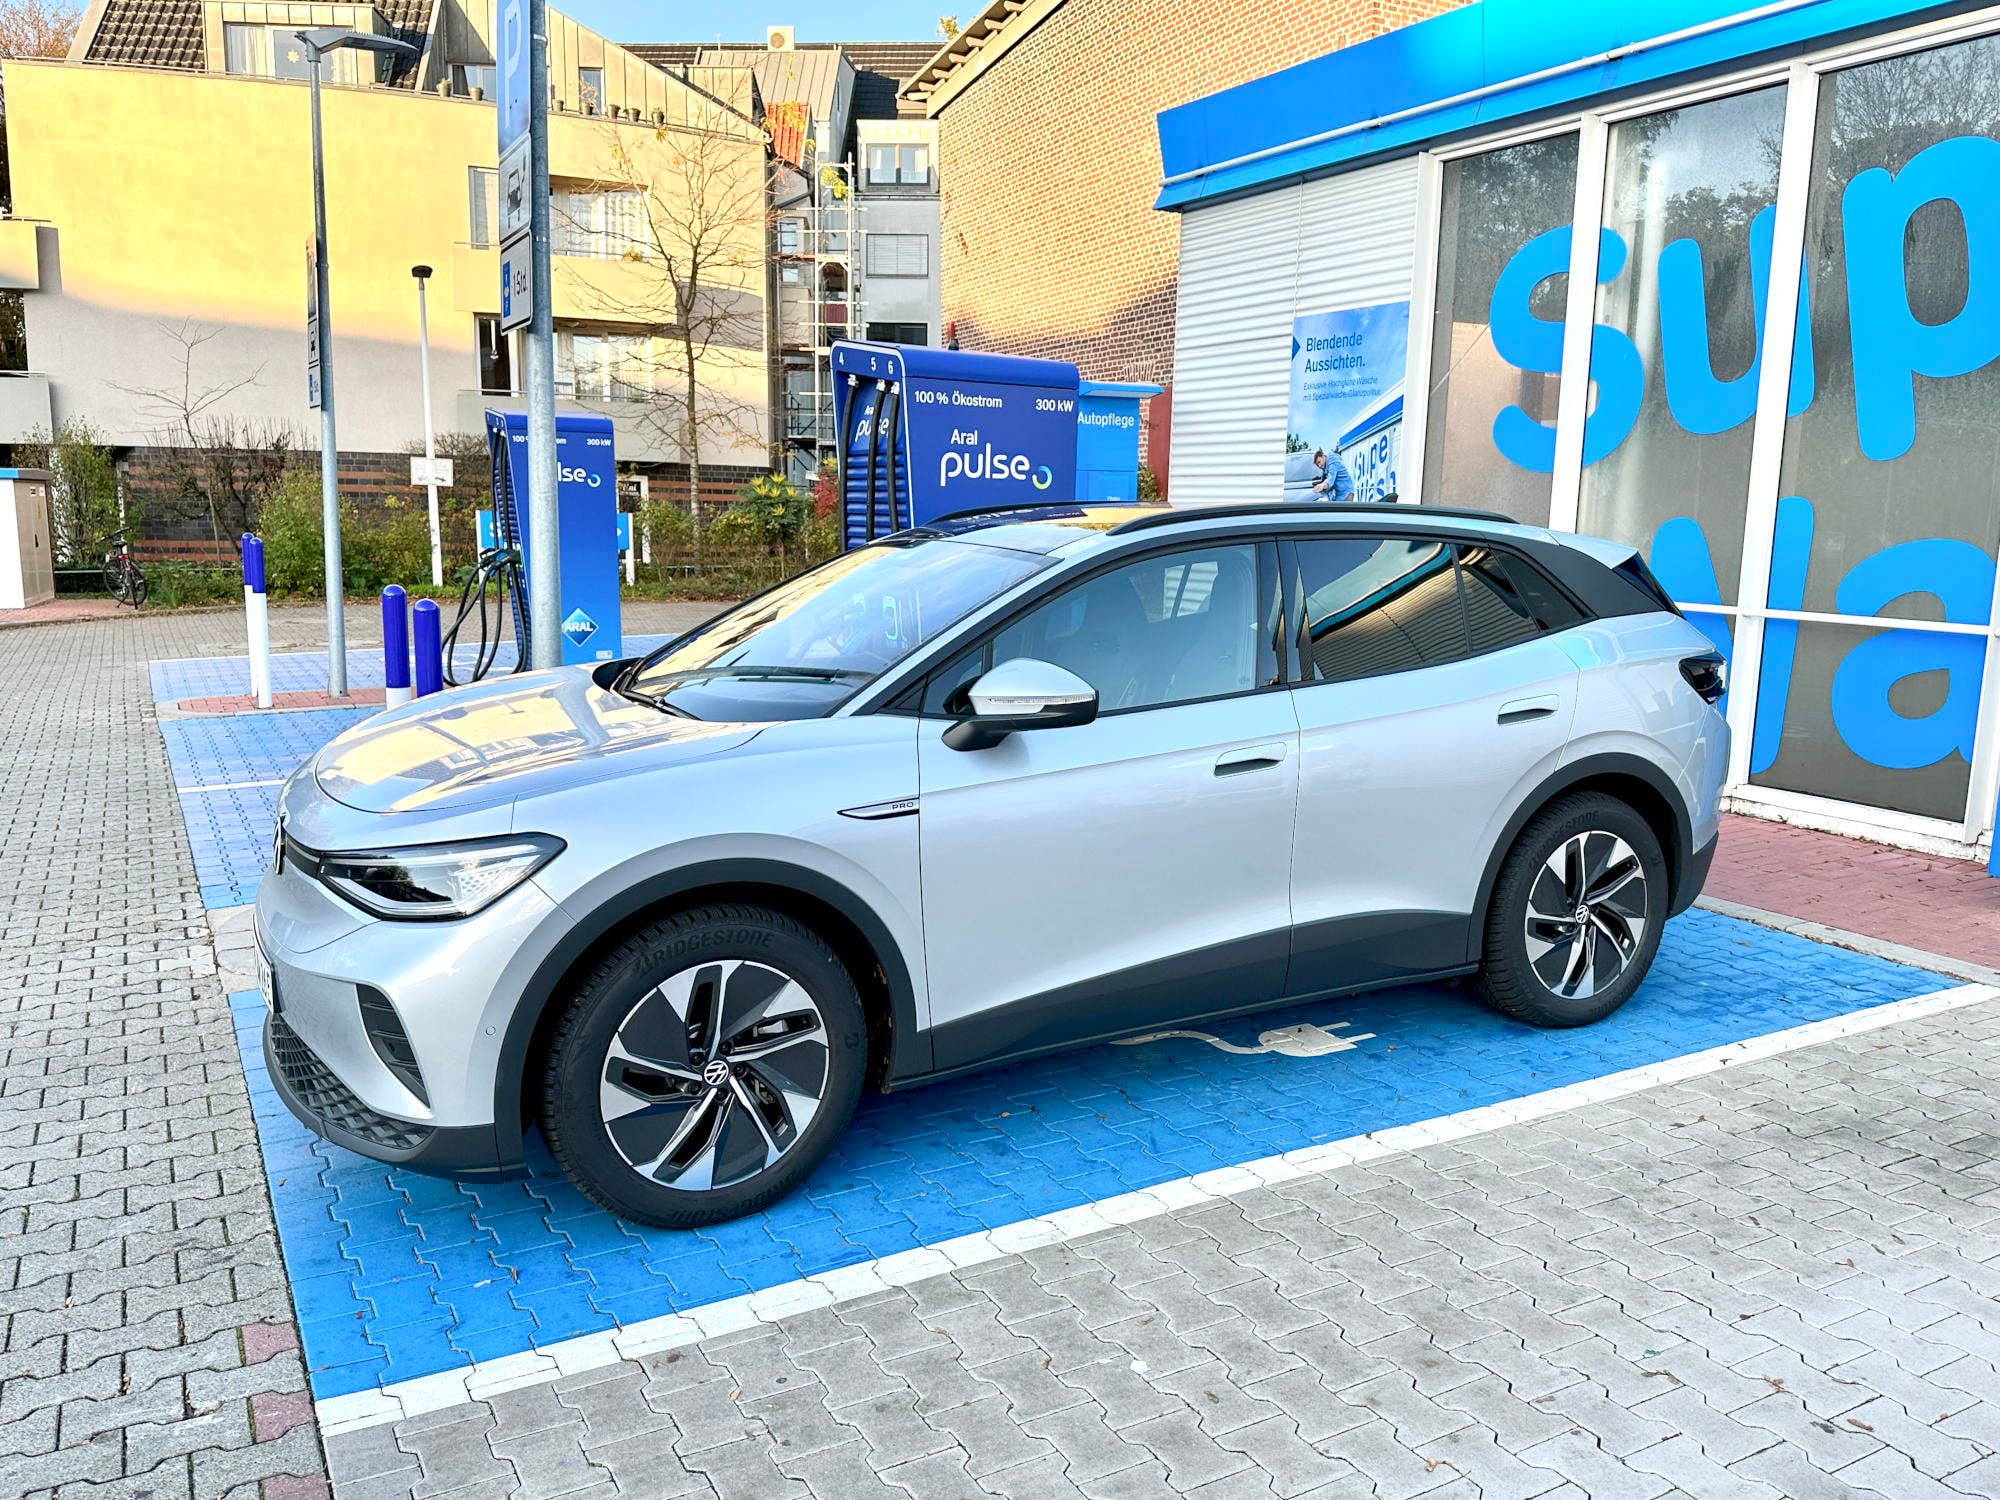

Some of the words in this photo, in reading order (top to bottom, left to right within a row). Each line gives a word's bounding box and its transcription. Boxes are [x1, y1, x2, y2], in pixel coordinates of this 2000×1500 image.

[1306, 332, 1363, 352] Blendende
[838, 352, 844, 366] 4
[870, 357, 877, 371] 5
[887, 360, 894, 375] 6
[1304, 354, 1365, 373] Aussichten.
[914, 390, 934, 404] 100
[937, 391, 949, 405] %
[952, 390, 1003, 408] Ökostrom
[1035, 399, 1056, 412] 300
[1057, 399, 1074, 412] kW
[864, 404, 874, 416] Ara
[1077, 411, 1135, 429] Autopflege
[512, 434, 525, 443] 100
[586, 438, 600, 446] 300
[600, 438, 611, 446] kW
[950, 428, 978, 446] Aral
[557, 461, 587, 483] lse
[940, 442, 1030, 487] pulse
[564, 621, 594, 632] ARAL
[891, 801, 914, 810] PRO
